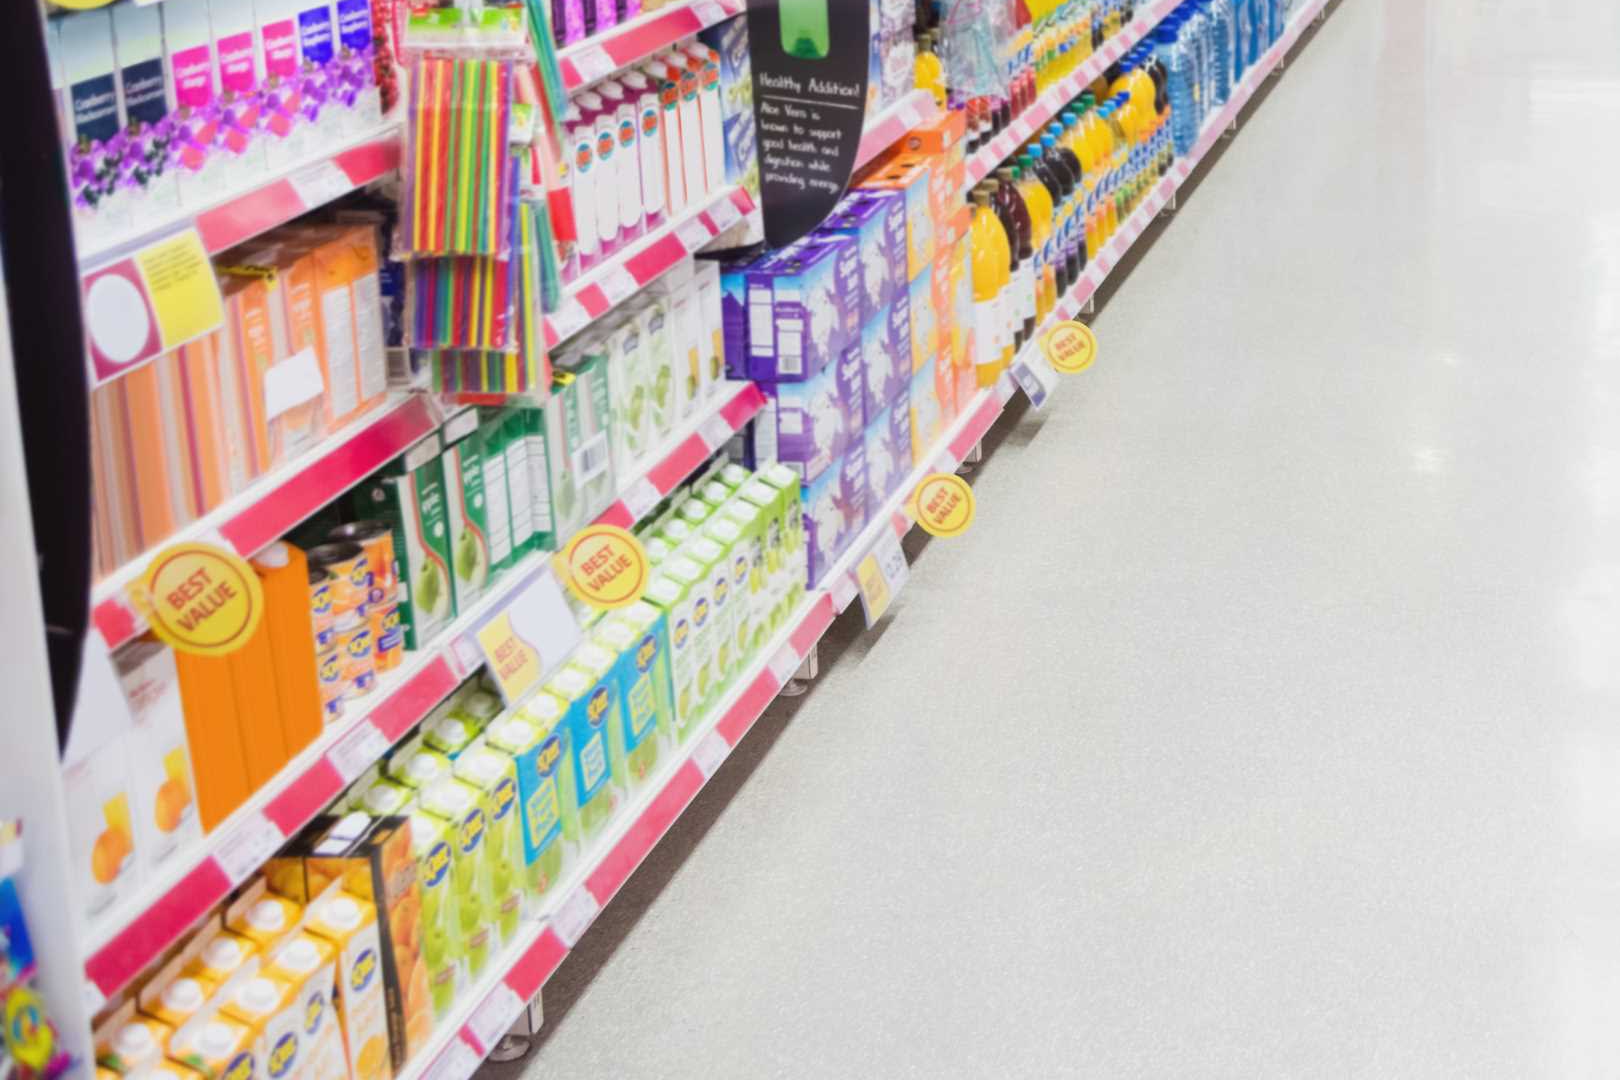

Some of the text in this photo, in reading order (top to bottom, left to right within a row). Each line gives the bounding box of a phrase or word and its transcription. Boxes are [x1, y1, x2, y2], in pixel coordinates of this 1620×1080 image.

[760, 72, 801, 94] Healthy
[761, 101, 780, 116] Aloe
[785, 104, 807, 119] Vera
[761, 119, 842, 140] known to support
[763, 139, 839, 157] good health and
[765, 153, 831, 172] digestion while
[765, 172, 806, 191] providing
[1055, 333, 1077, 351] BEST
[1059, 340, 1085, 361] VALUE
[927, 487, 947, 514] BEST
[935, 492, 960, 524] VALUE
[580, 543, 615, 576] BEST
[587, 553, 632, 591] VALUE
[167, 568, 212, 610] BEST
[177, 580, 238, 631] VALUE
[494, 637, 516, 664] BEST
[501, 648, 529, 681] VALUE
